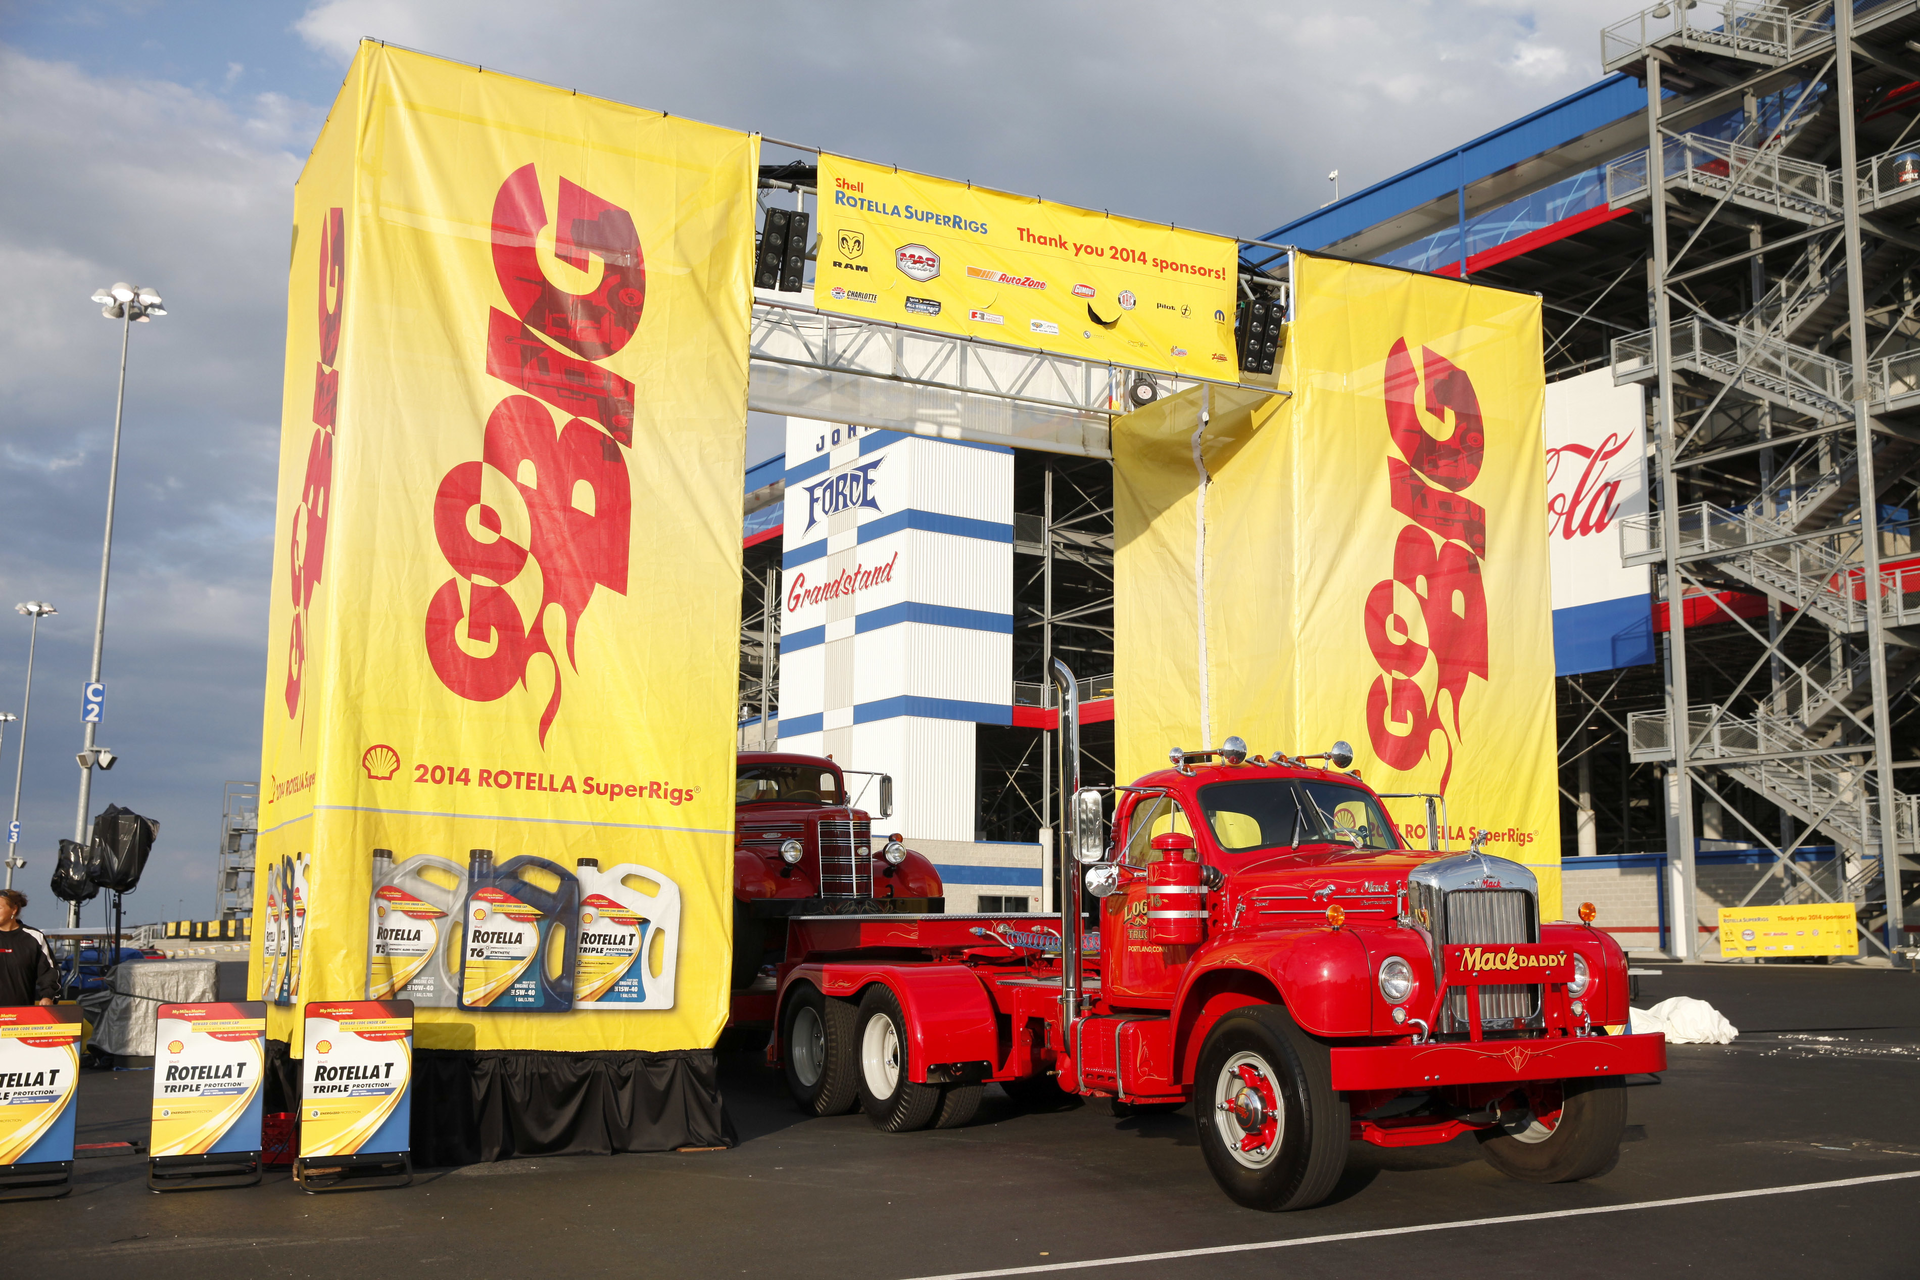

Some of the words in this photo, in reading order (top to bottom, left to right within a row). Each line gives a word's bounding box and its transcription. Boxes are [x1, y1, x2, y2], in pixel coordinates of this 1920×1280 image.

[835, 177, 864, 194] Shell
[900, 252, 936, 268] MAC
[1017, 227, 1069, 251] Thank
[1072, 242, 1105, 257] you
[1109, 245, 1147, 266] 2014
[1152, 256, 1227, 281] sponsors!
[833, 261, 868, 273] RAM
[998, 273, 1047, 290] AutoZone
[846, 290, 878, 302] CHARLOTTE
[816, 424, 874, 453] JOH
[802, 454, 889, 539] FORCE
[787, 551, 898, 613] Grandstand
[86, 683, 104, 702] C
[85, 703, 100, 722] 2
[413, 762, 471, 787] 2014
[478, 768, 577, 794] ROTELLA
[9, 821, 20, 832] C
[9, 832, 18, 843] 3
[1468, 826, 1534, 847] SperRigs
[1360, 881, 1390, 893] Mack
[1481, 879, 1502, 889] Mack
[376, 926, 421, 942] ROTELLA
[471, 929, 523, 945] ROTELLA
[580, 931, 626, 946] ROTELLA
[629, 933, 636, 946] T
[375, 944, 386, 954] T5
[470, 947, 485, 958] T6
[579, 946, 605, 954] TRIPLE
[1459, 946, 1520, 972] Mack
[1519, 954, 1568, 967] DADDY
[49, 1069, 60, 1086] T
[165, 1064, 233, 1082] ROTELLA
[236, 1062, 247, 1079] T
[314, 1064, 380, 1082] ROTELLA
[384, 1062, 395, 1079] T
[12, 1089, 55, 1097] PROTECTION
[164, 1084, 201, 1094] TRIPLE
[313, 1084, 350, 1094] TRIPLE
